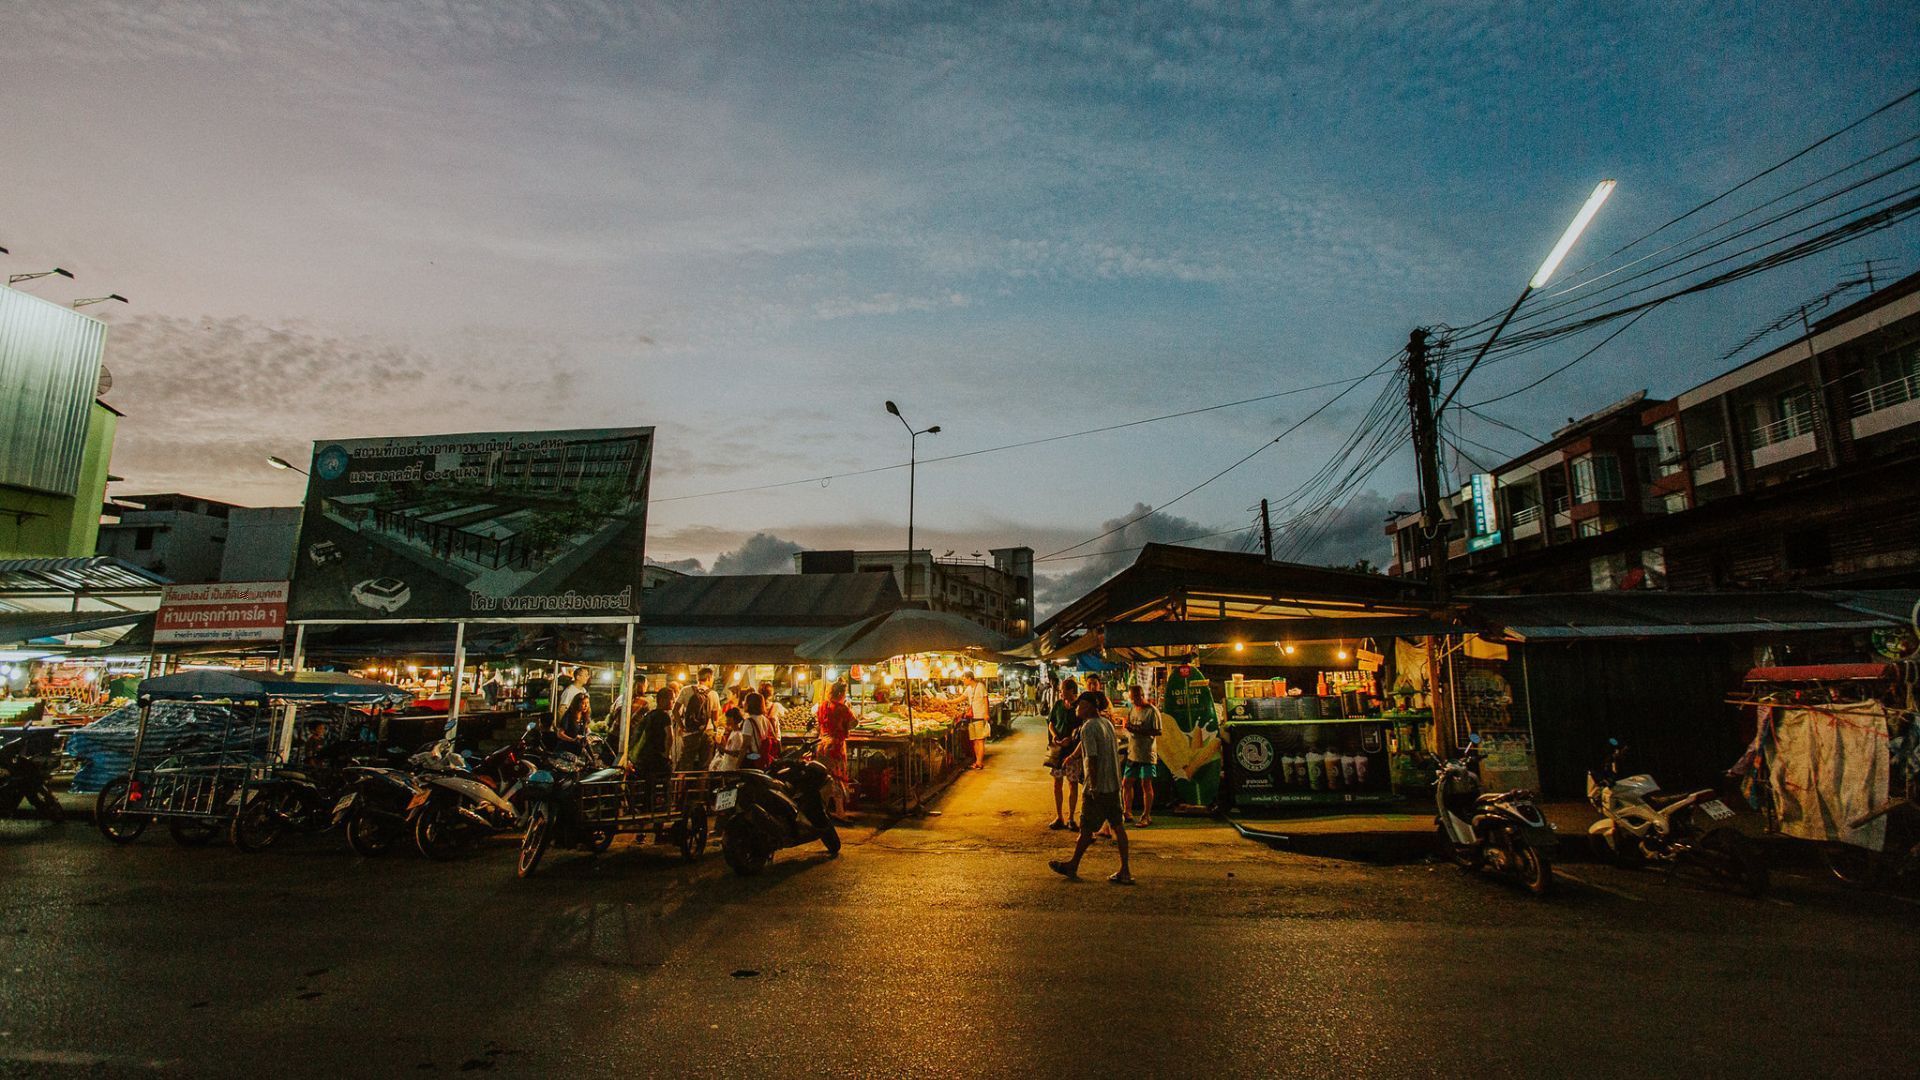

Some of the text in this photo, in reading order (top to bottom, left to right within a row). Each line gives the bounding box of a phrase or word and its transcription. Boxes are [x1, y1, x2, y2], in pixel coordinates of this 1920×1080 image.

[471, 585, 632, 611] โดย เทศบาลเมืองกระบี่
[268, 608, 277, 623] ๆ
